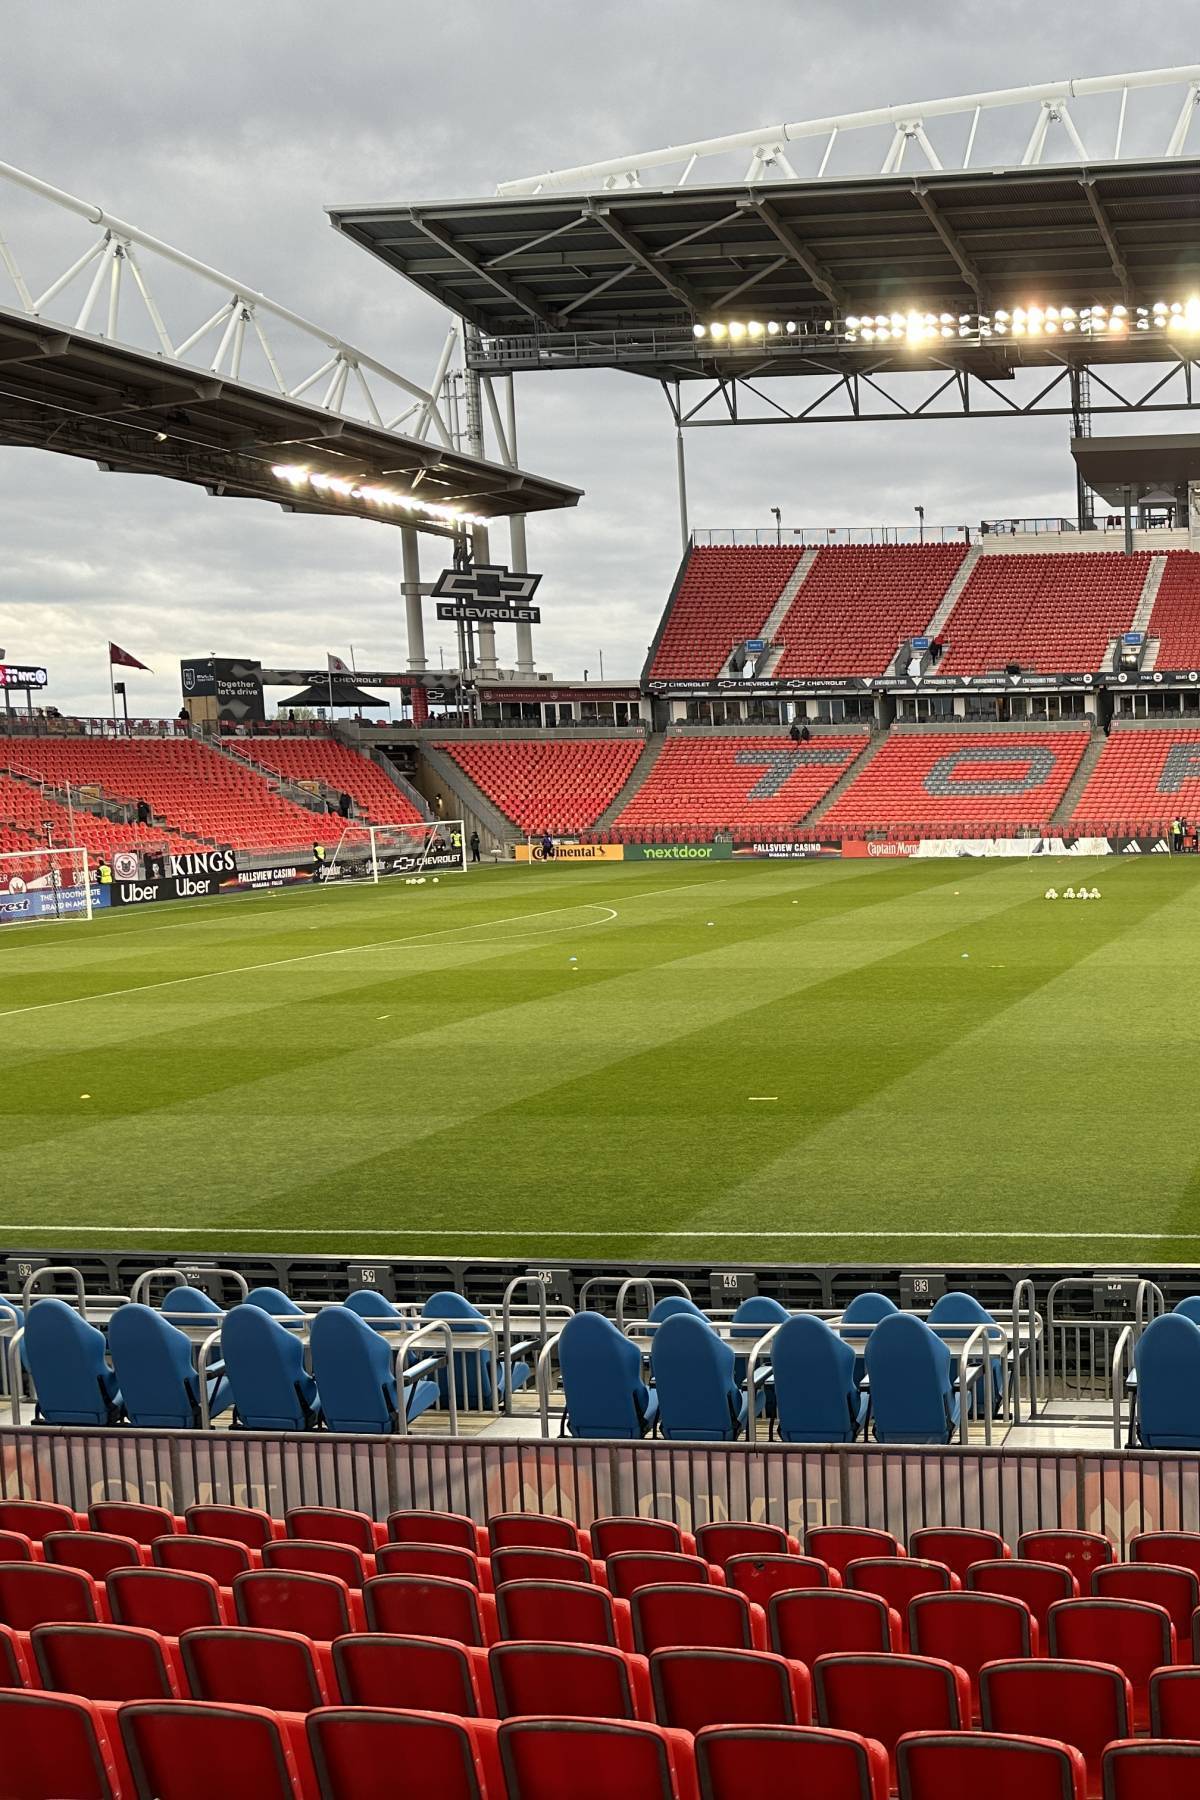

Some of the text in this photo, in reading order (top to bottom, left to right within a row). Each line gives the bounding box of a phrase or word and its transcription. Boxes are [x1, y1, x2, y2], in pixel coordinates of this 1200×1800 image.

[441, 607, 537, 620] CHEVROLET
[18, 671, 36, 682] NYC
[644, 845, 712, 858] nextdoor
[753, 843, 821, 852] FALLSVIEW CASINO
[868, 841, 897, 856] Captain
[170, 850, 235, 876] KINGS
[416, 854, 461, 866] CHEVROLET
[238, 868, 296, 883] FALLSVIEW CASINO
[120, 884, 158, 902] Uber
[175, 878, 210, 896] Uber
[362, 1270, 374, 1282] 59
[723, 1275, 736, 1287] 46
[914, 1280, 927, 1292] 83
